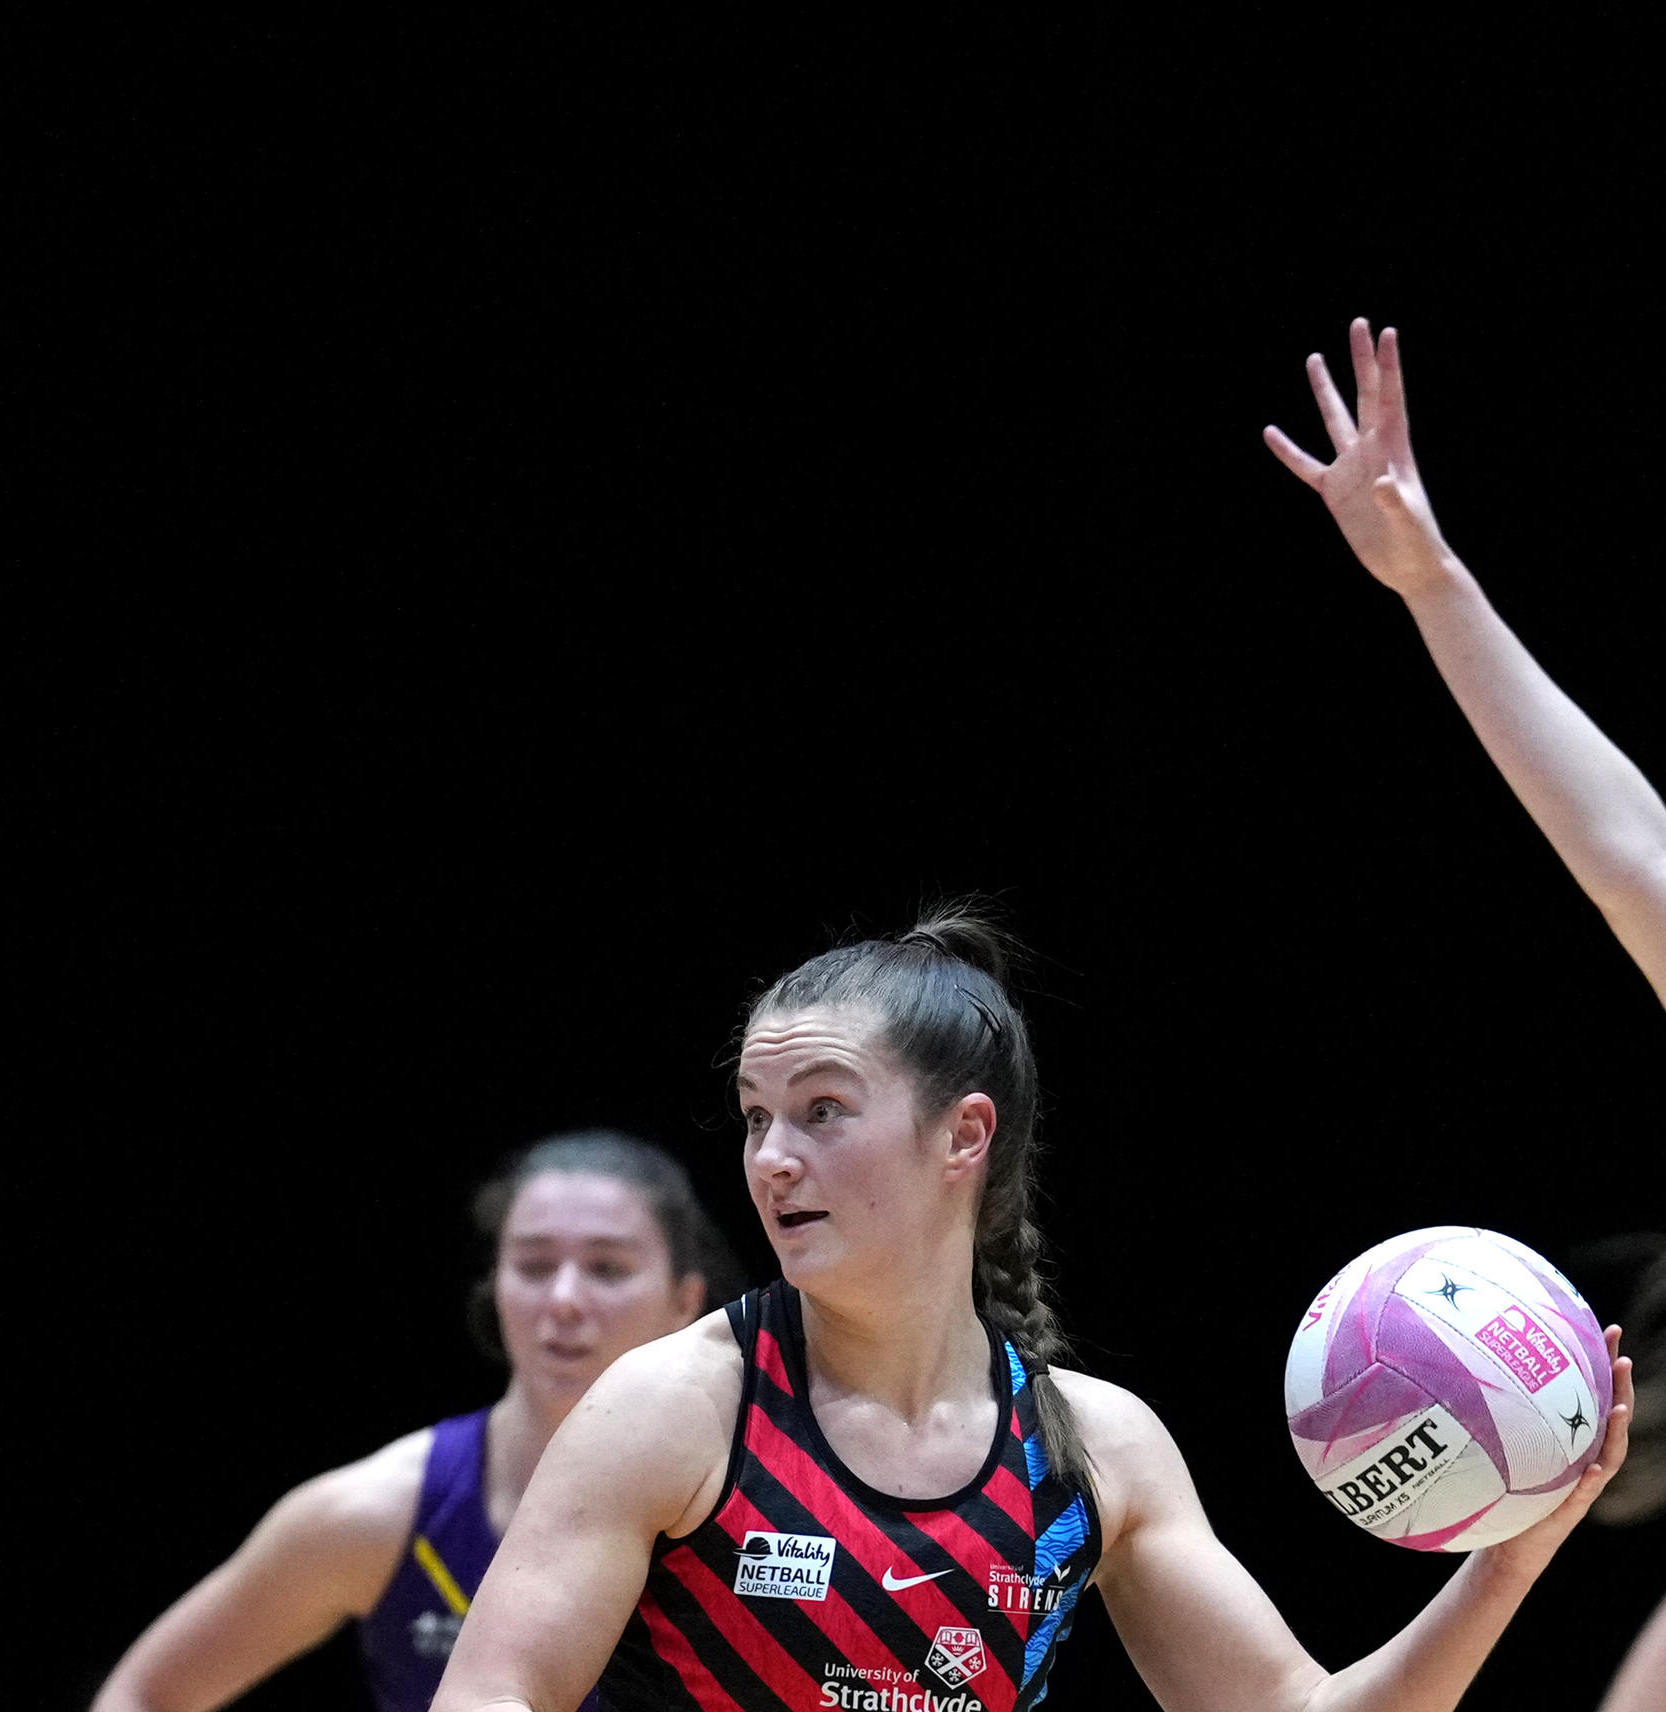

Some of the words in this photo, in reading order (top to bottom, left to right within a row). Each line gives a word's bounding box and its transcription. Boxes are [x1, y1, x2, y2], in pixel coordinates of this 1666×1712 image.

[1479, 1330, 1539, 1391] SUPERLEAGUE
[1487, 1316, 1548, 1386] NETBALL
[777, 1536, 831, 1568] Vitality
[740, 1563, 826, 1585] NETBALL
[989, 1570, 1046, 1588] Strathclyde
[738, 1581, 824, 1599] SUPERLEAGUE
[988, 1584, 1064, 1611] SIRENS
[824, 1662, 901, 1685] University
[903, 1669, 920, 1683] of
